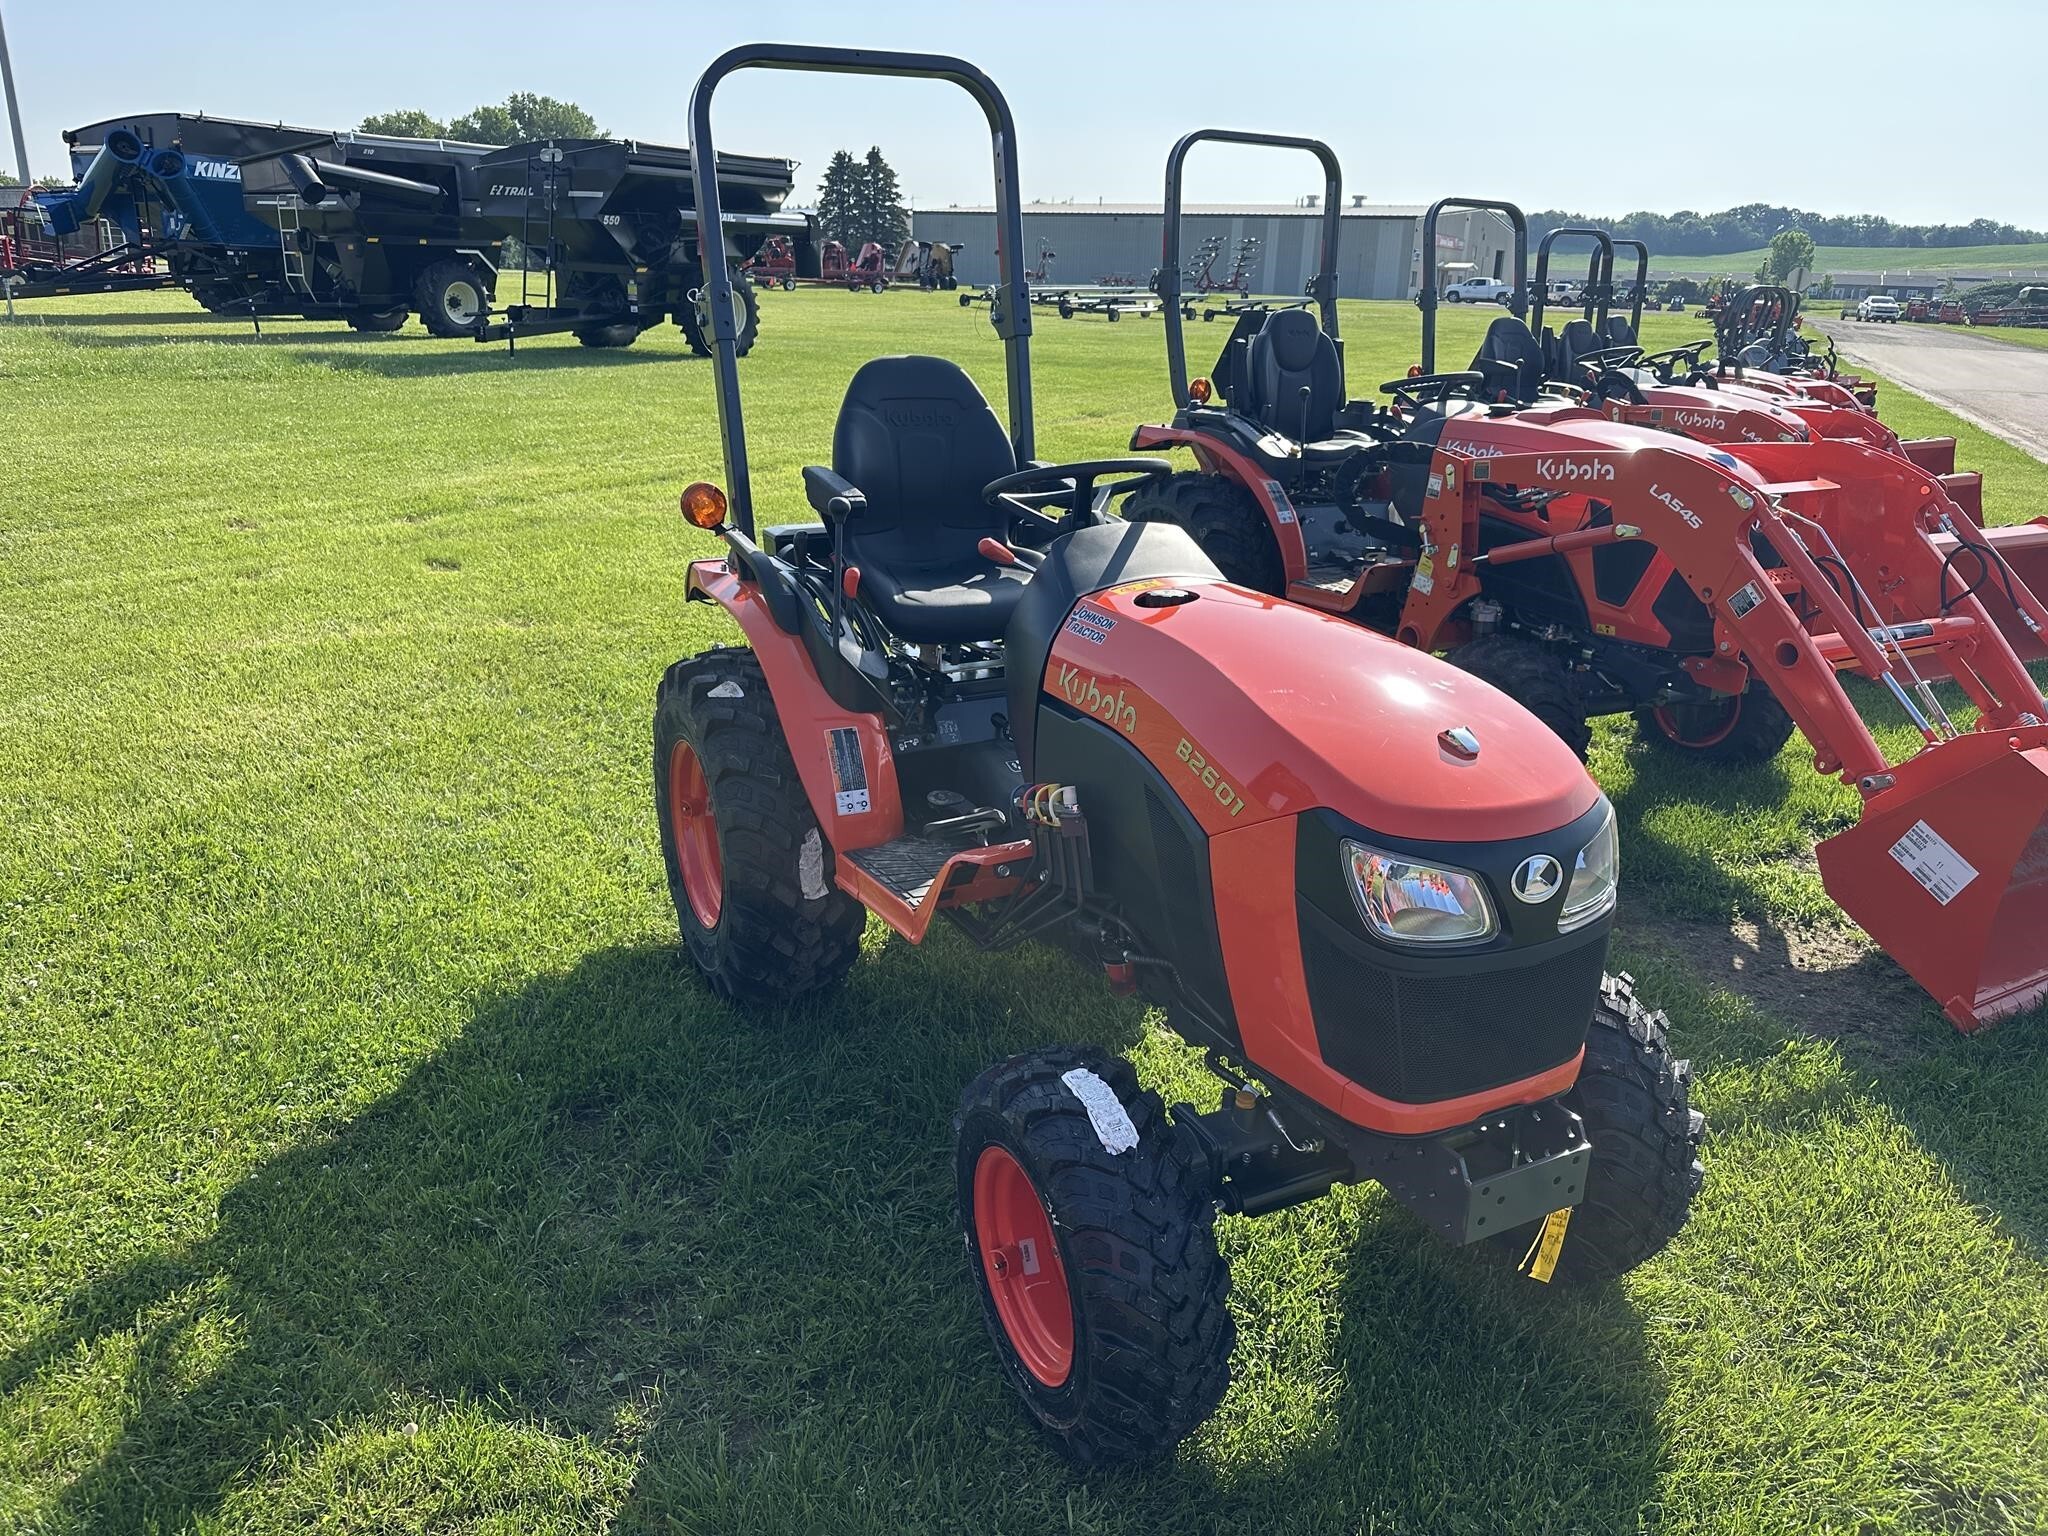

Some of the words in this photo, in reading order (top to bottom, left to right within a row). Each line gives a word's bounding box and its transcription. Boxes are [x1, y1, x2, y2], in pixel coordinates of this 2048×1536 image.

[603, 215, 620, 225] 550
[1674, 410, 1726, 430] Kubota
[1536, 458, 1615, 481] Kubota
[1649, 483, 1704, 529] LA545
[1065, 617, 1107, 644] TRACTOR
[1072, 605, 1117, 630] JOHNSON
[1058, 663, 1137, 734] Kubota
[1175, 737, 1246, 817] B2601
